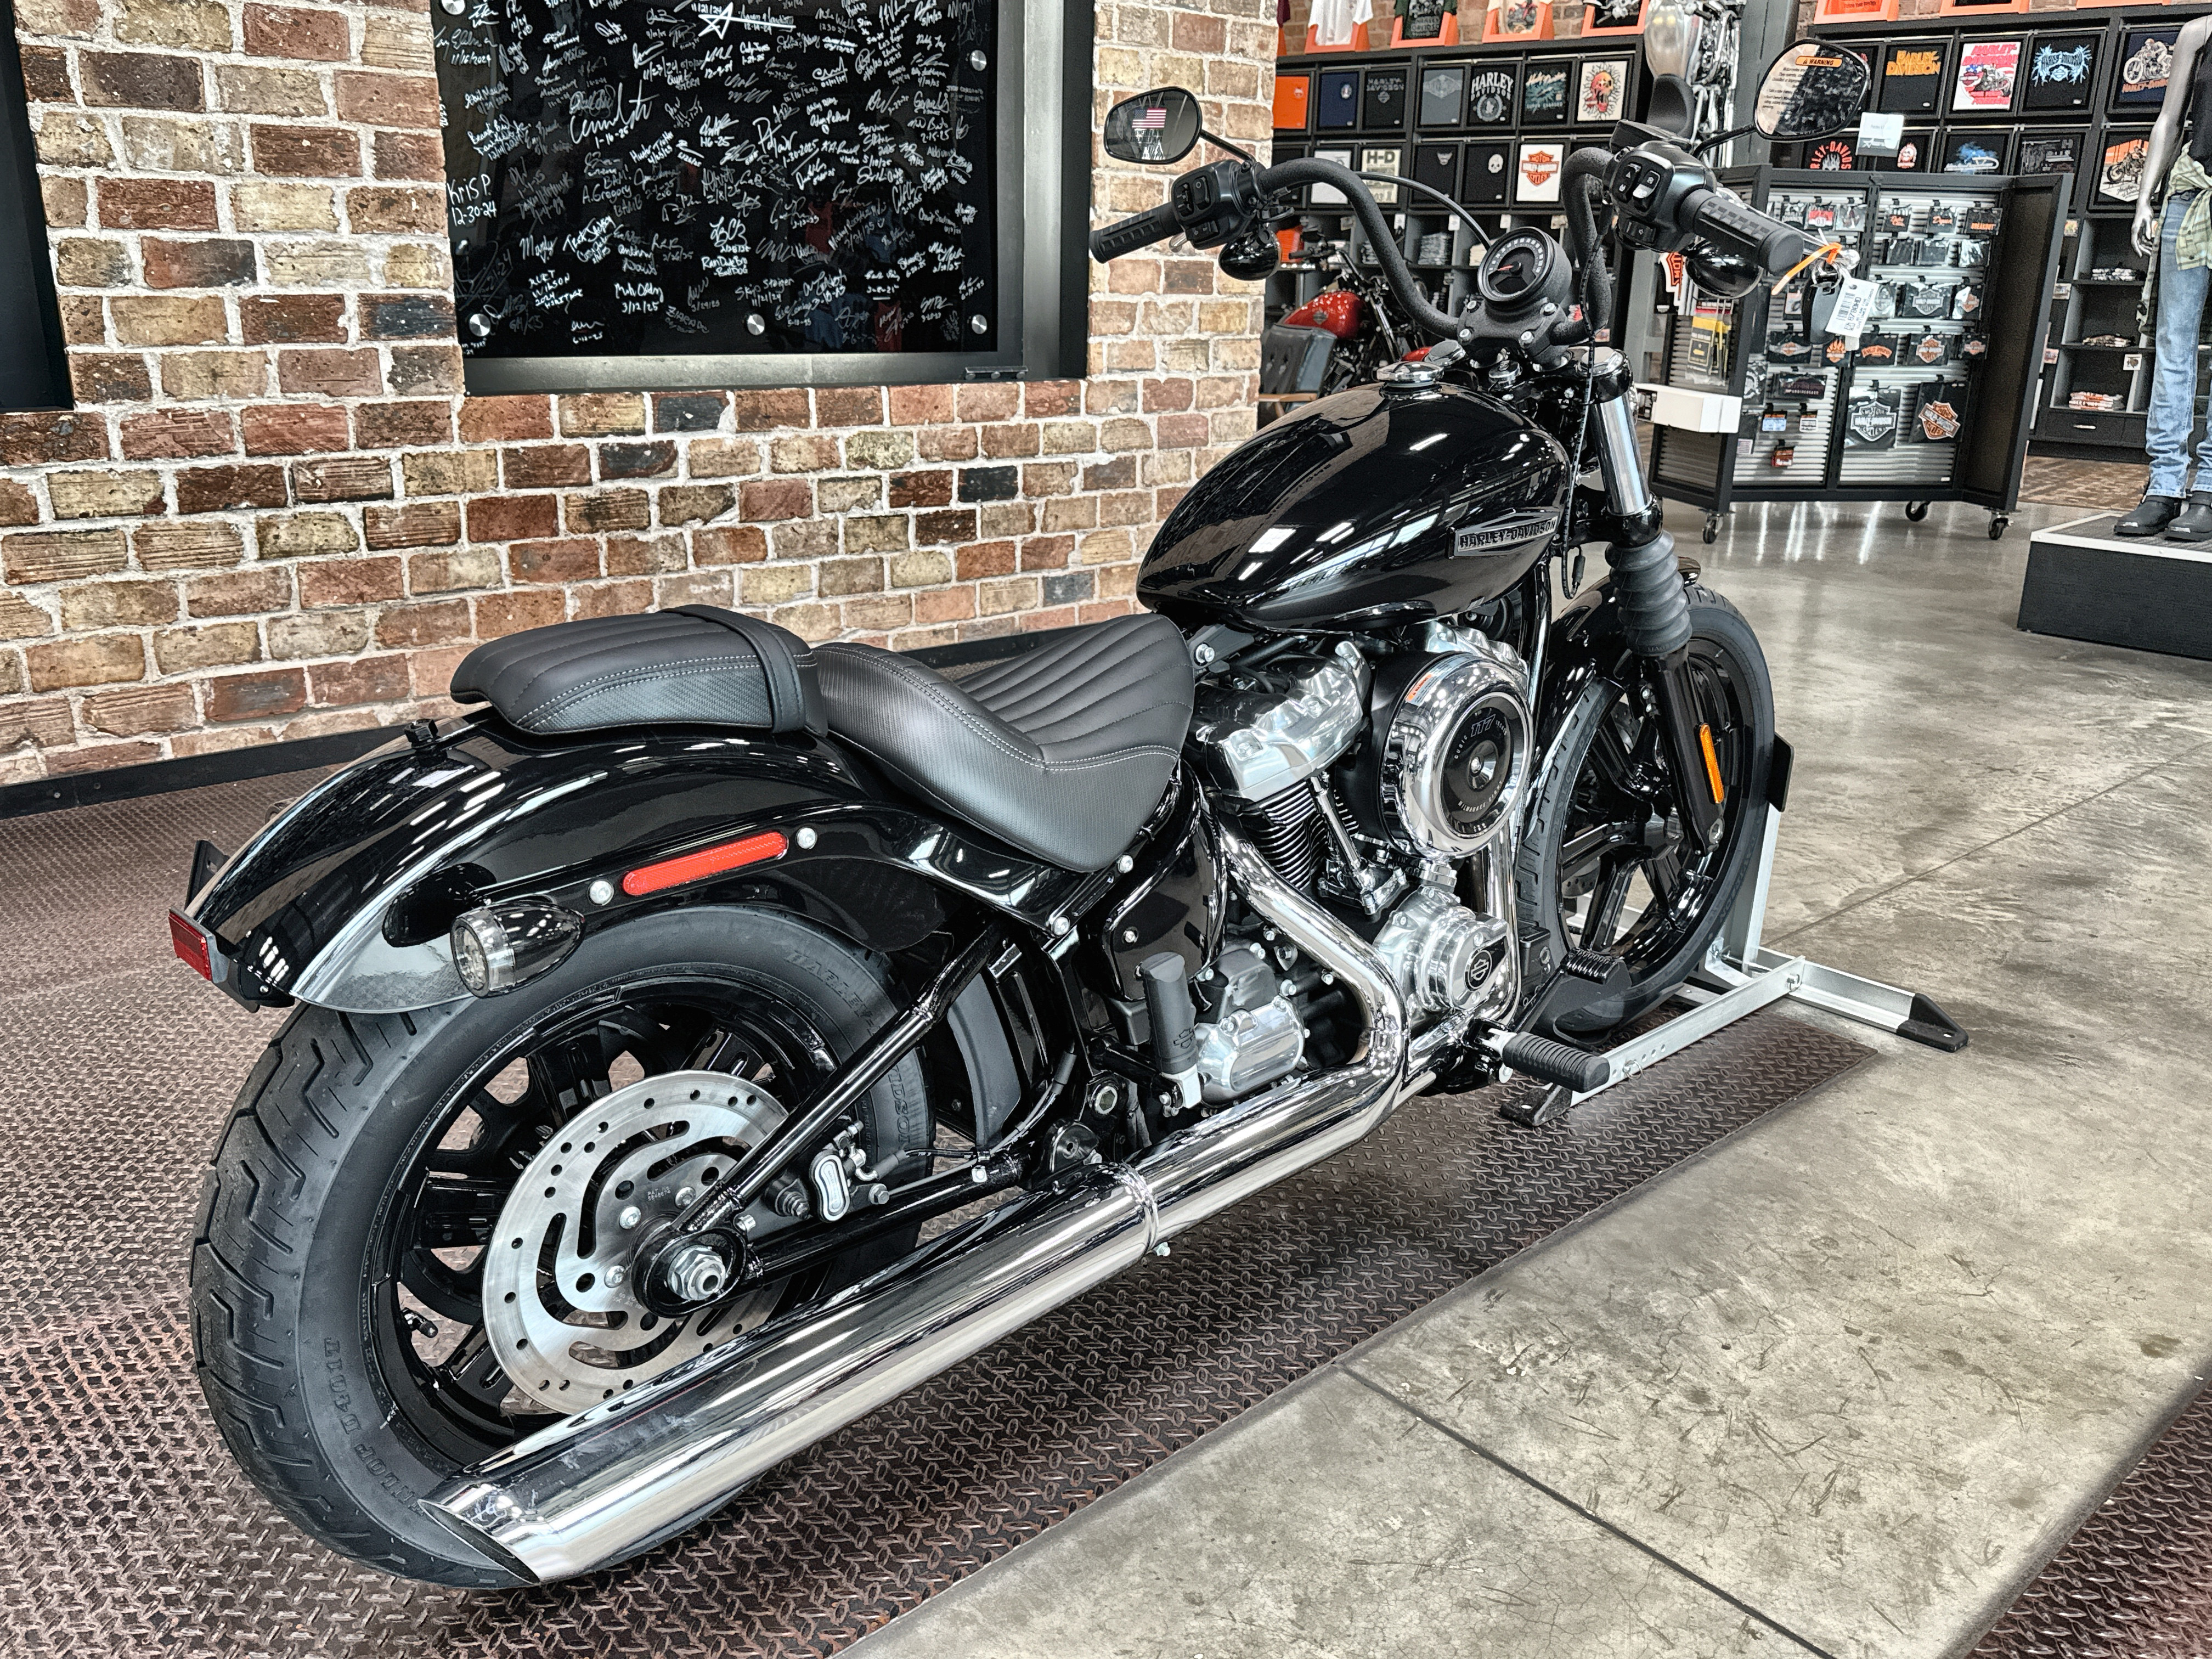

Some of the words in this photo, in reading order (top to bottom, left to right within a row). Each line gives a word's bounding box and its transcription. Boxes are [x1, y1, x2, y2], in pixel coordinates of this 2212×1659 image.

[1471, 71, 1514, 94] HARLEY
[1367, 150, 1396, 165] H-D
[621, 301, 659, 315] 3/12/25
[1460, 518, 1558, 549] HARLEY-DAVIDSON
[1470, 713, 1496, 737] 117
[1458, 800, 1486, 812] MILWAUKEE
